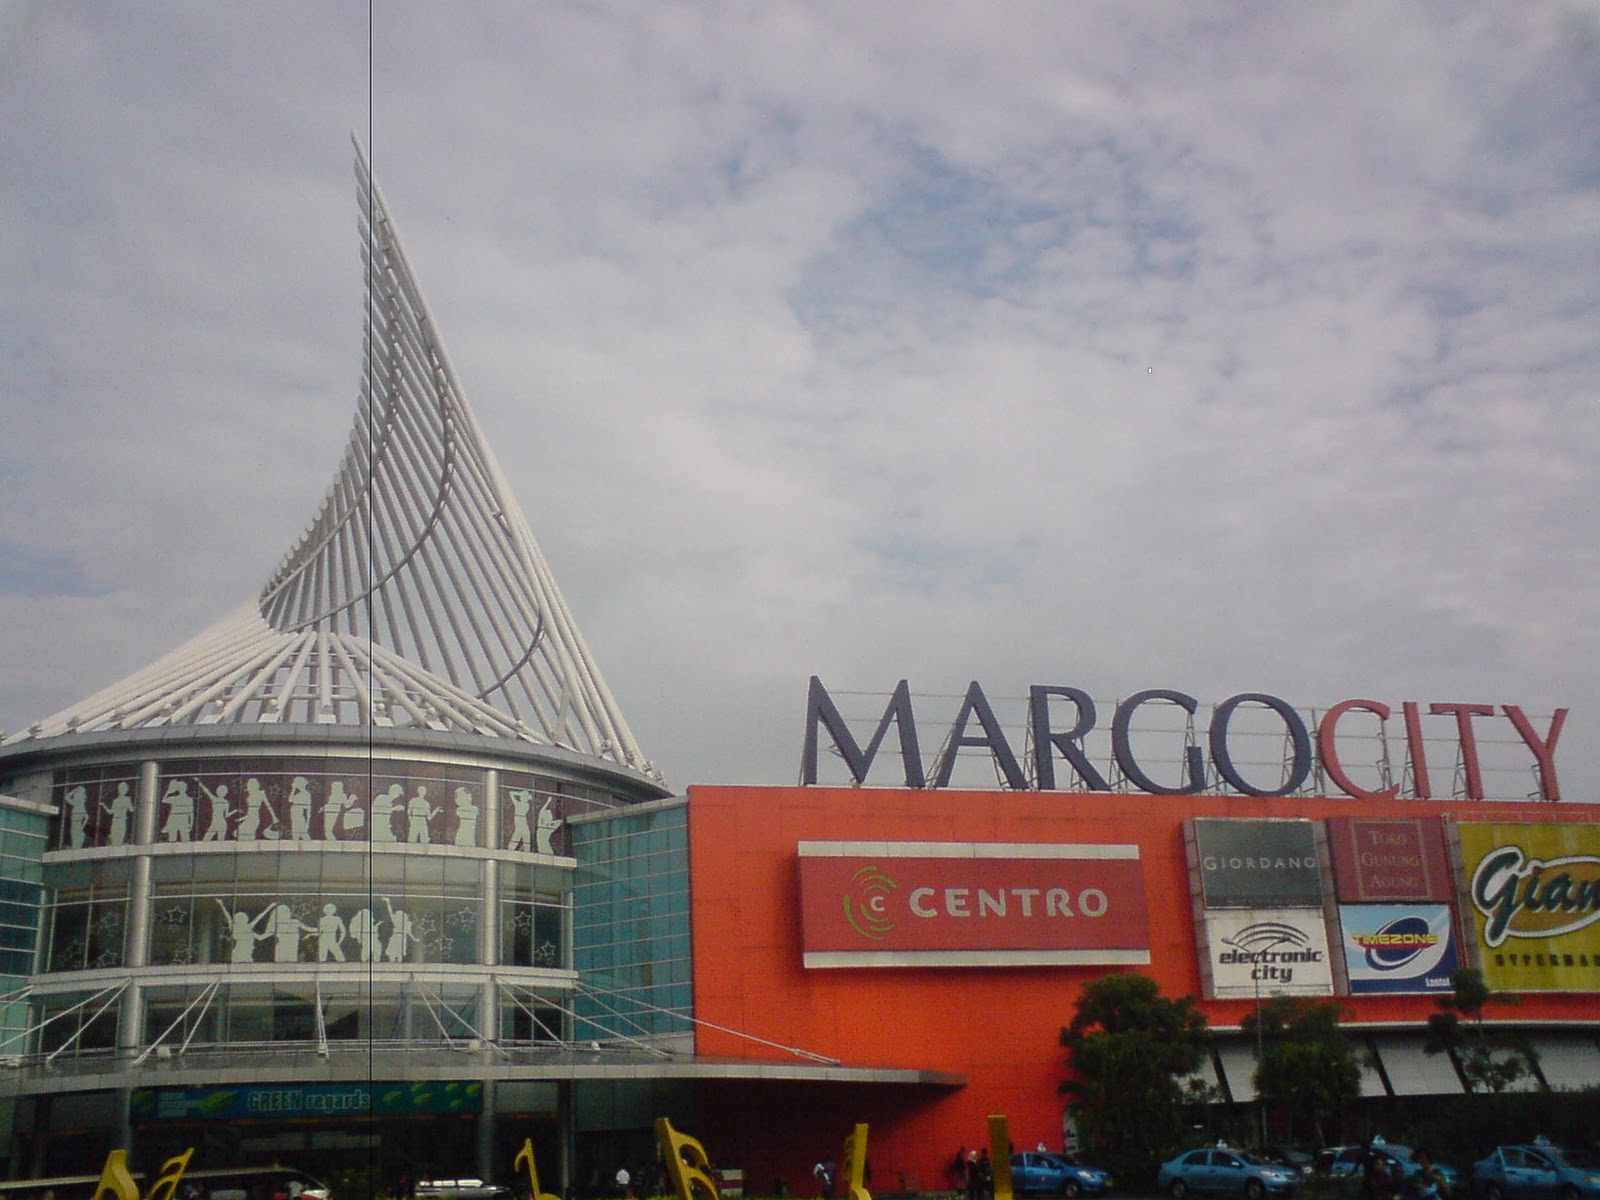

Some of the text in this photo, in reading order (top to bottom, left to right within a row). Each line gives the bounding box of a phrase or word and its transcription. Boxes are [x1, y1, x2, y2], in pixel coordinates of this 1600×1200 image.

[1203, 856, 1317, 871] GIORDANO
[909, 887, 1109, 918] CENTRO
[1353, 933, 1439, 946] TIMEZONE
[1218, 947, 1323, 965] electronic
[1250, 965, 1293, 983] city
[248, 1089, 301, 1111] GREEN
